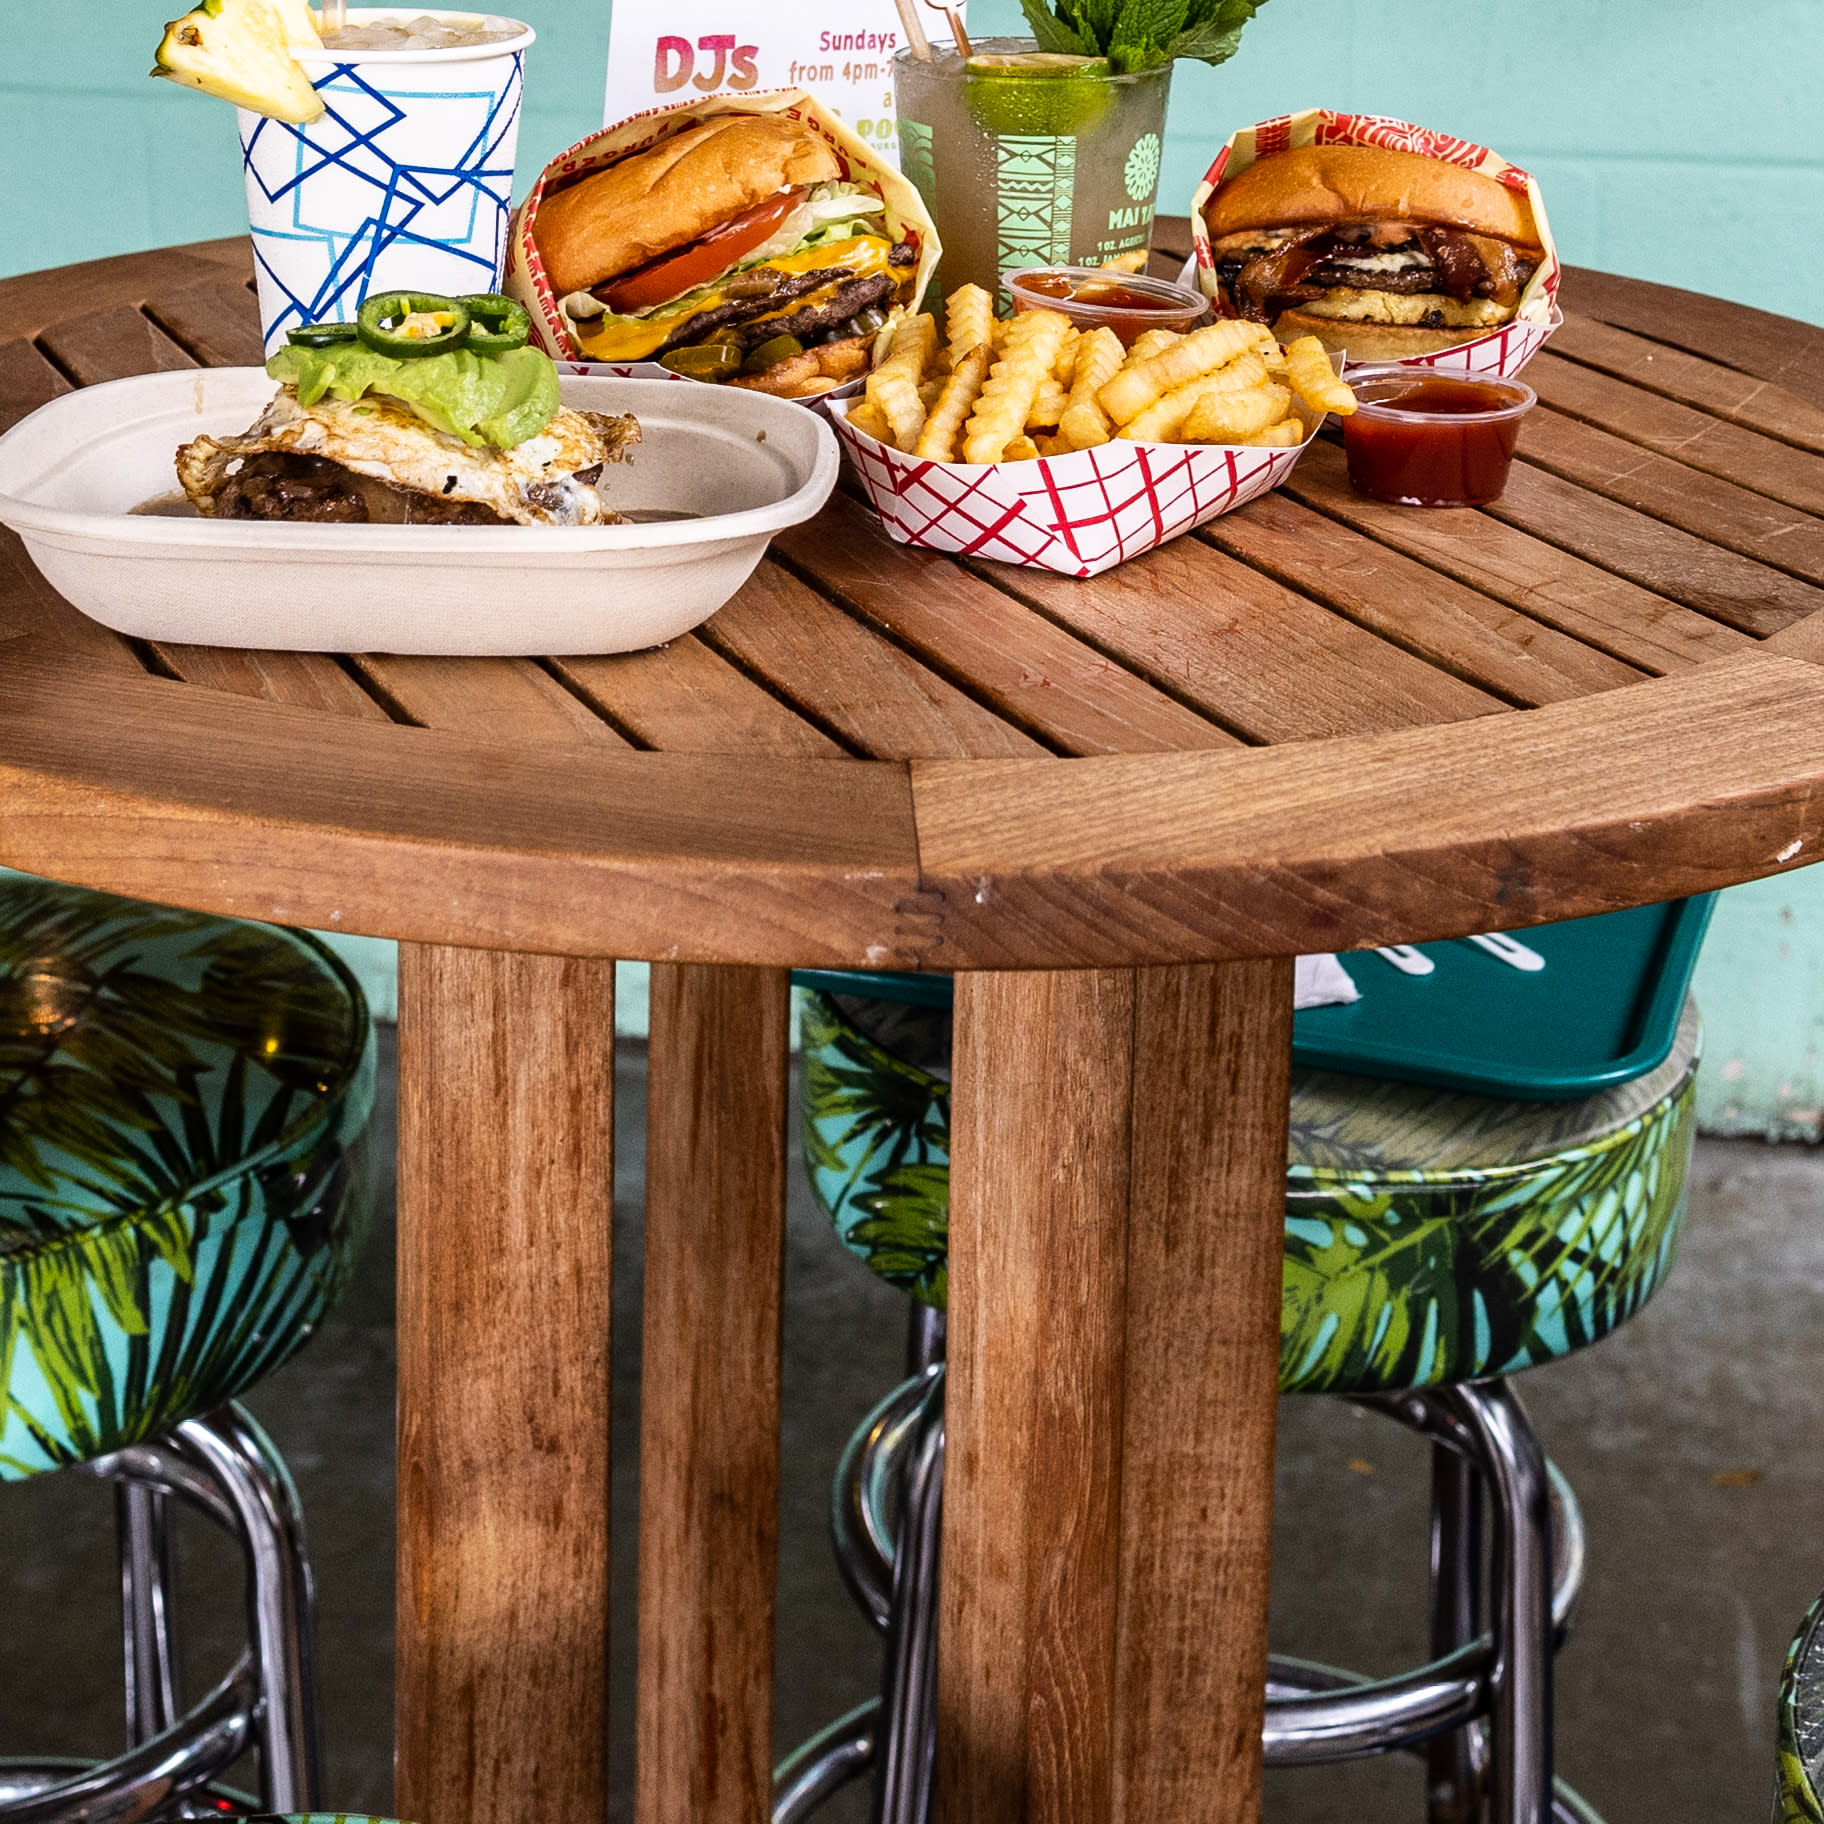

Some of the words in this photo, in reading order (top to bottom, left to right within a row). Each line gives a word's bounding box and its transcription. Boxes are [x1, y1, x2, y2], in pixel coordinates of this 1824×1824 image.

[819, 29, 896, 55] Sundays
[653, 34, 760, 93] DJs
[789, 60, 834, 84] from
[1107, 206, 1140, 231] MAI
